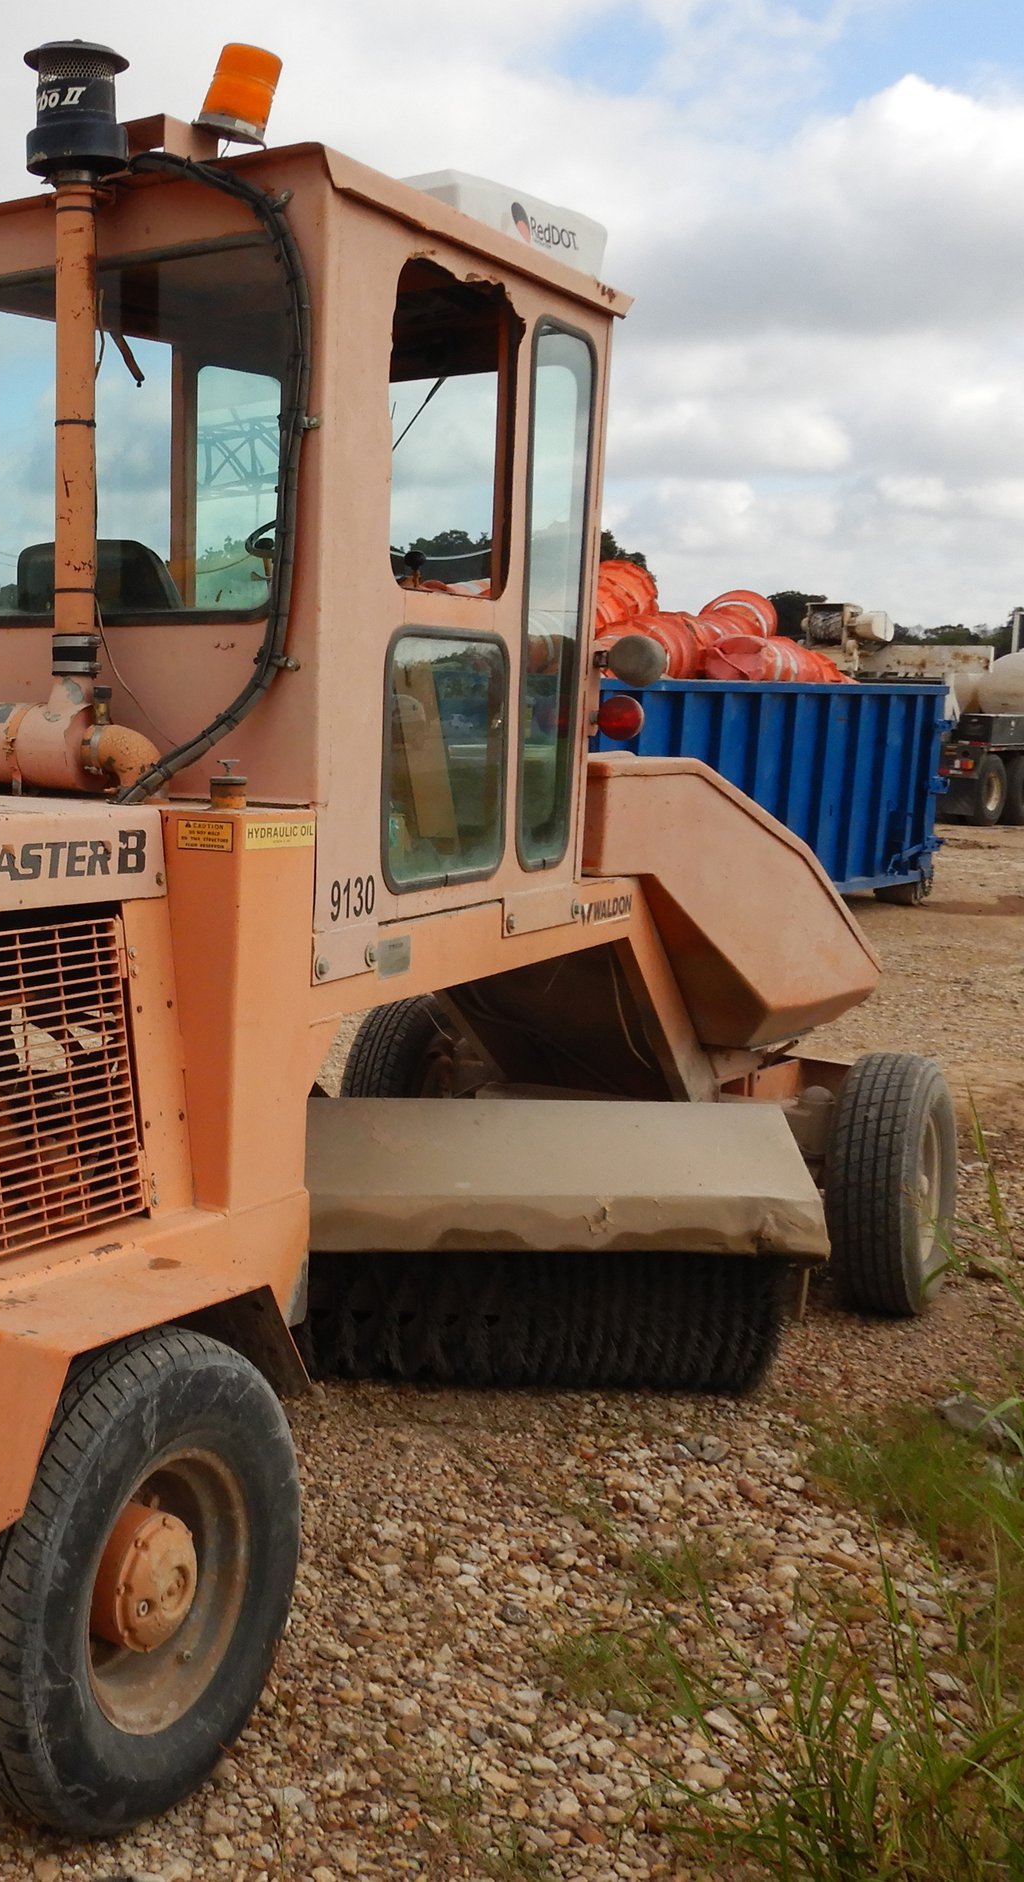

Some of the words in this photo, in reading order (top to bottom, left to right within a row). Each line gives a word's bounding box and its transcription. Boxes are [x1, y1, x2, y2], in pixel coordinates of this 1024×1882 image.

[530, 216, 578, 251] RedDOT
[247, 825, 298, 839] HYDRAULIC
[300, 825, 314, 837] OIL
[330, 874, 376, 922] 9130
[593, 893, 632, 922] WALDON
